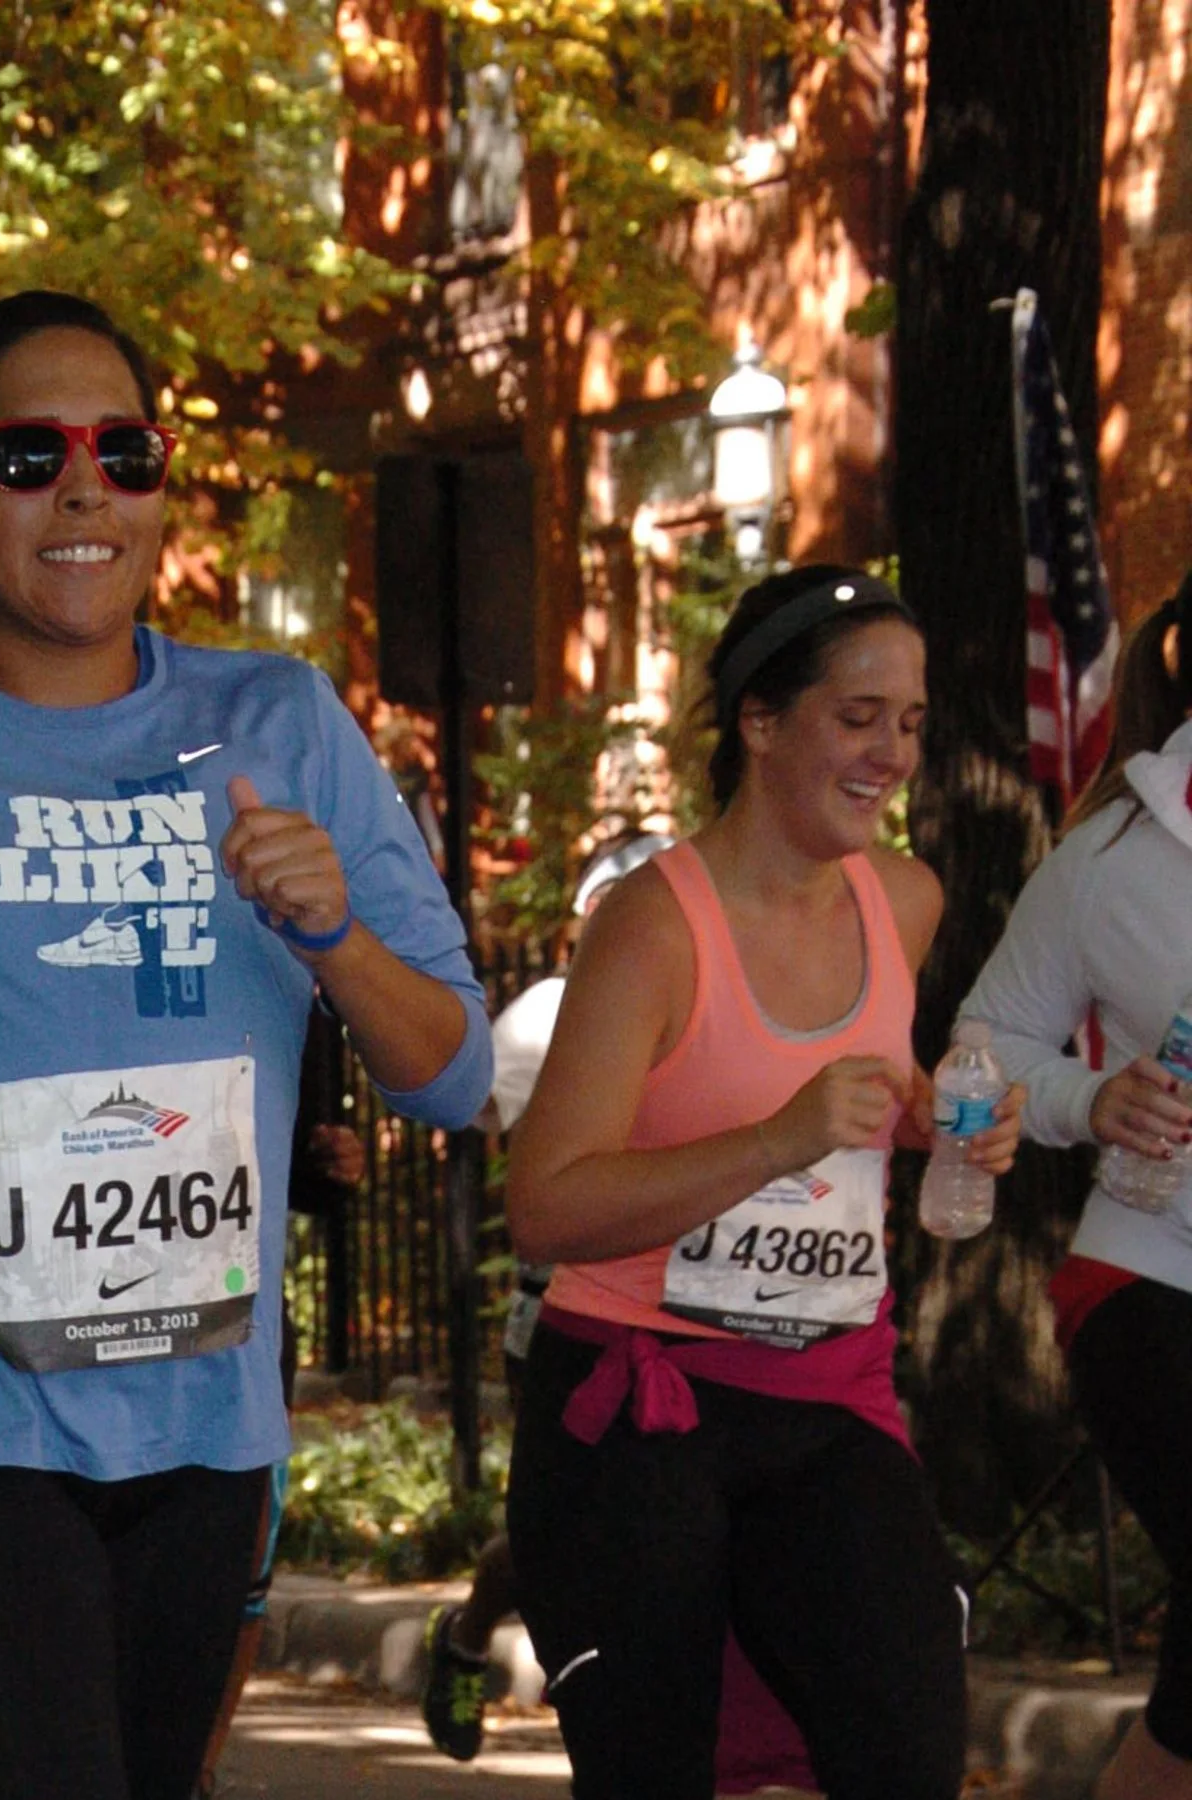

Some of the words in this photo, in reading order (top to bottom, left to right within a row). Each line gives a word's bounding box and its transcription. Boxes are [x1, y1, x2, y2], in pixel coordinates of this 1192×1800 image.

[8, 791, 207, 848] RUN
[62, 1131, 87, 1142] Bank
[90, 1128, 100, 1140] of
[103, 1126, 144, 1139] America
[63, 1143, 104, 1155] Chicago
[108, 1138, 155, 1151] Marathon
[52, 1165, 252, 1250] 42464
[680, 1222, 717, 1262] J
[730, 1225, 877, 1279] 43862
[65, 1321, 128, 1340] October
[133, 1317, 157, 1333] 13,
[161, 1312, 200, 1330] 2013
